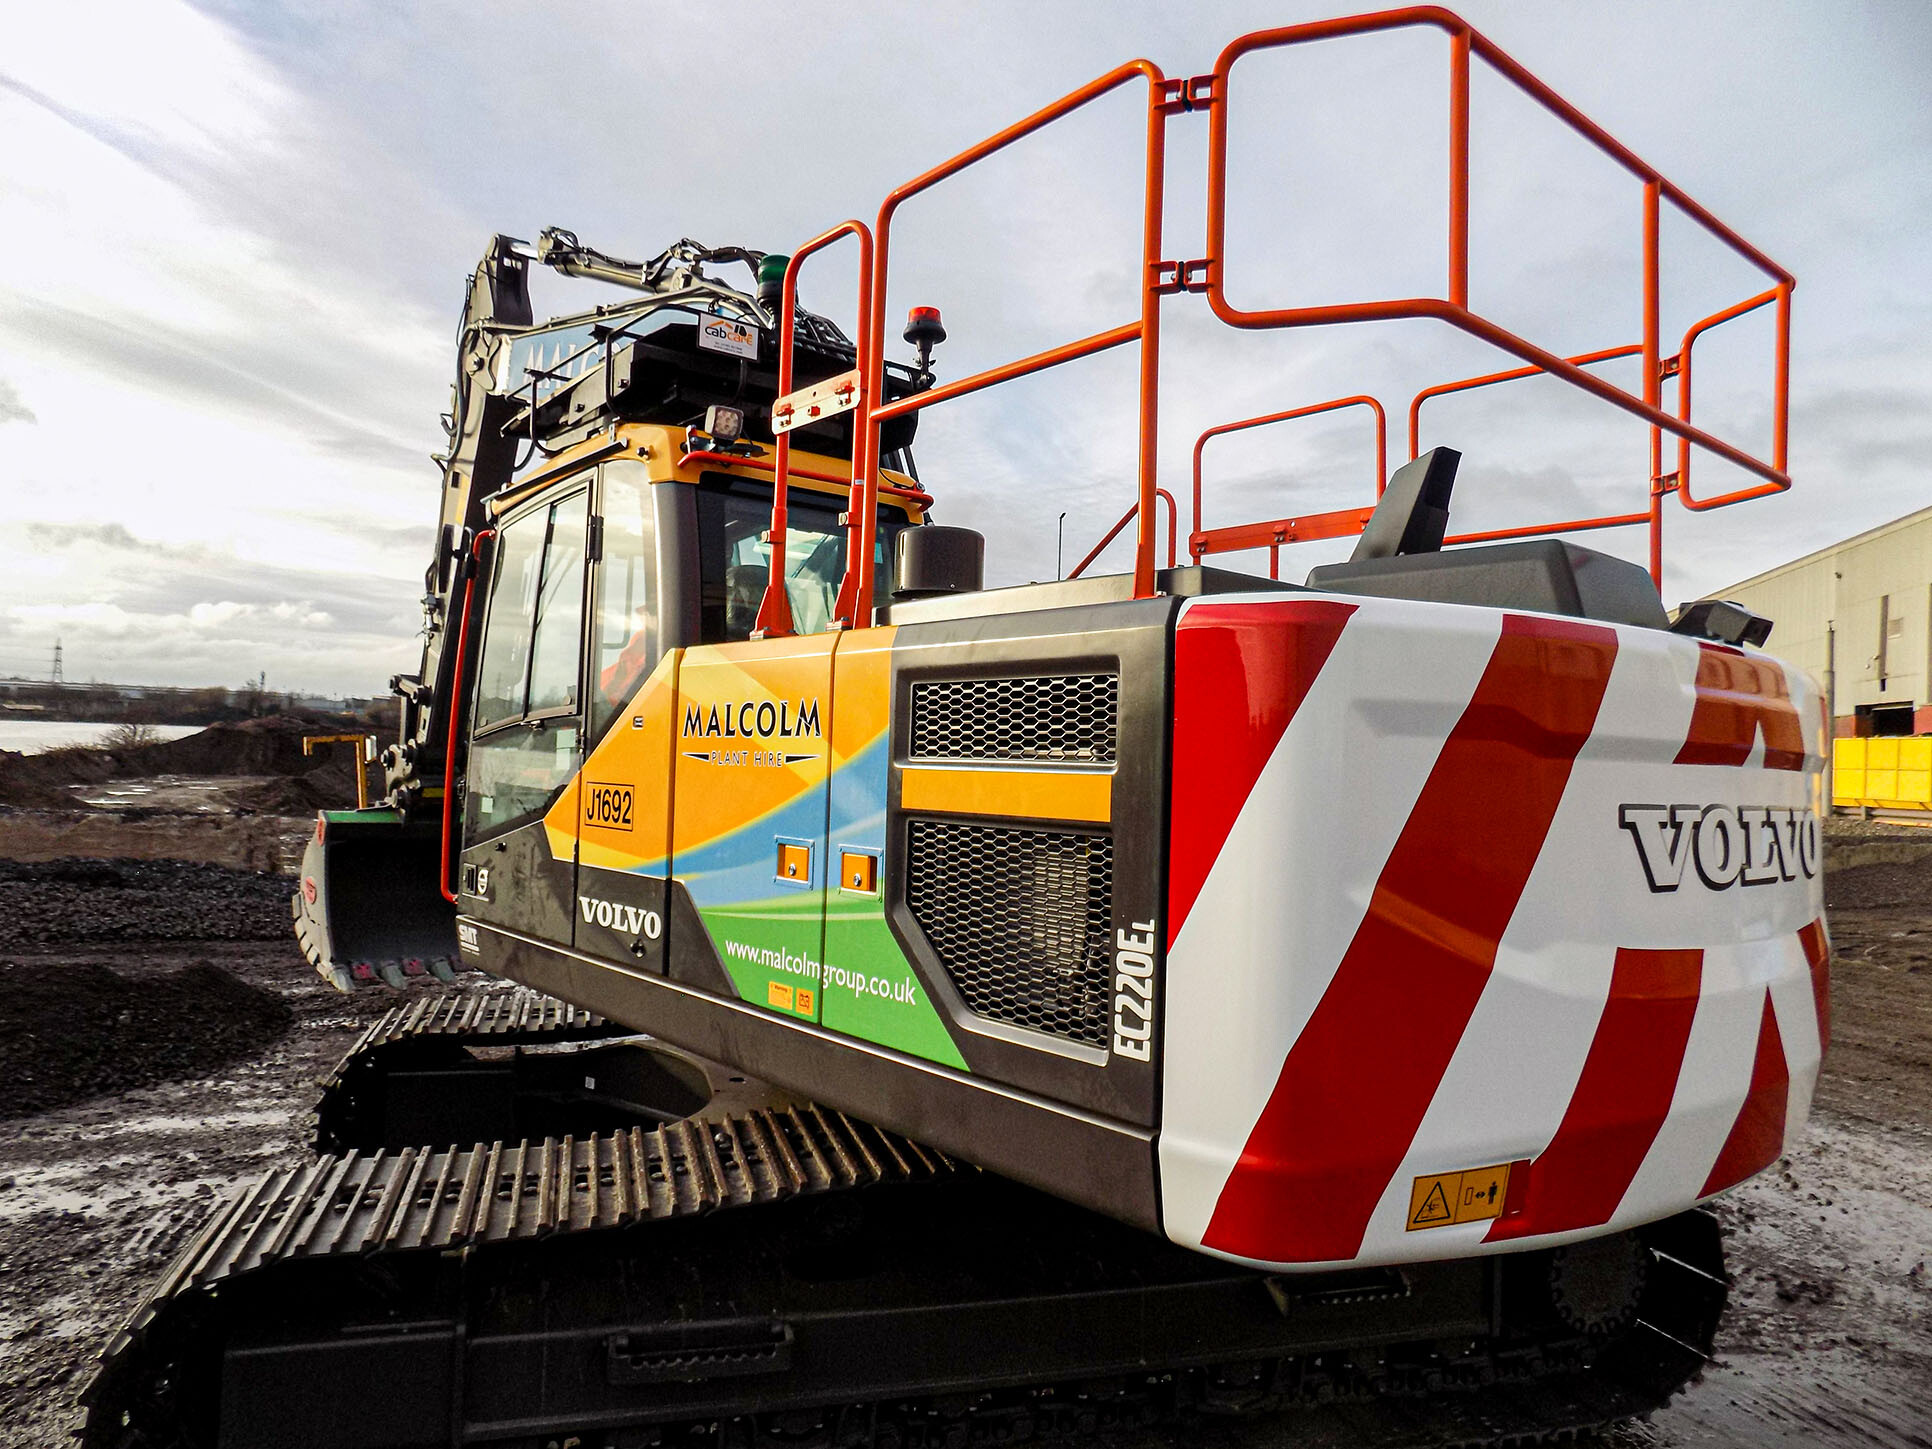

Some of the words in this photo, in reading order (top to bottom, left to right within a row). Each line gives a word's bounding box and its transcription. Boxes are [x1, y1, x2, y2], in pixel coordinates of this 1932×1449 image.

[682, 697, 822, 738] MALCOLM
[711, 751, 748, 766] PLANT
[753, 752, 783, 767] HIRE
[587, 788, 632, 825] J1692
[1618, 803, 1824, 893] VOLVO
[578, 895, 662, 940] VOLVO
[725, 940, 916, 1006] www.malcolmgroup.co.uk
[1113, 919, 1155, 1062] EC220EL
